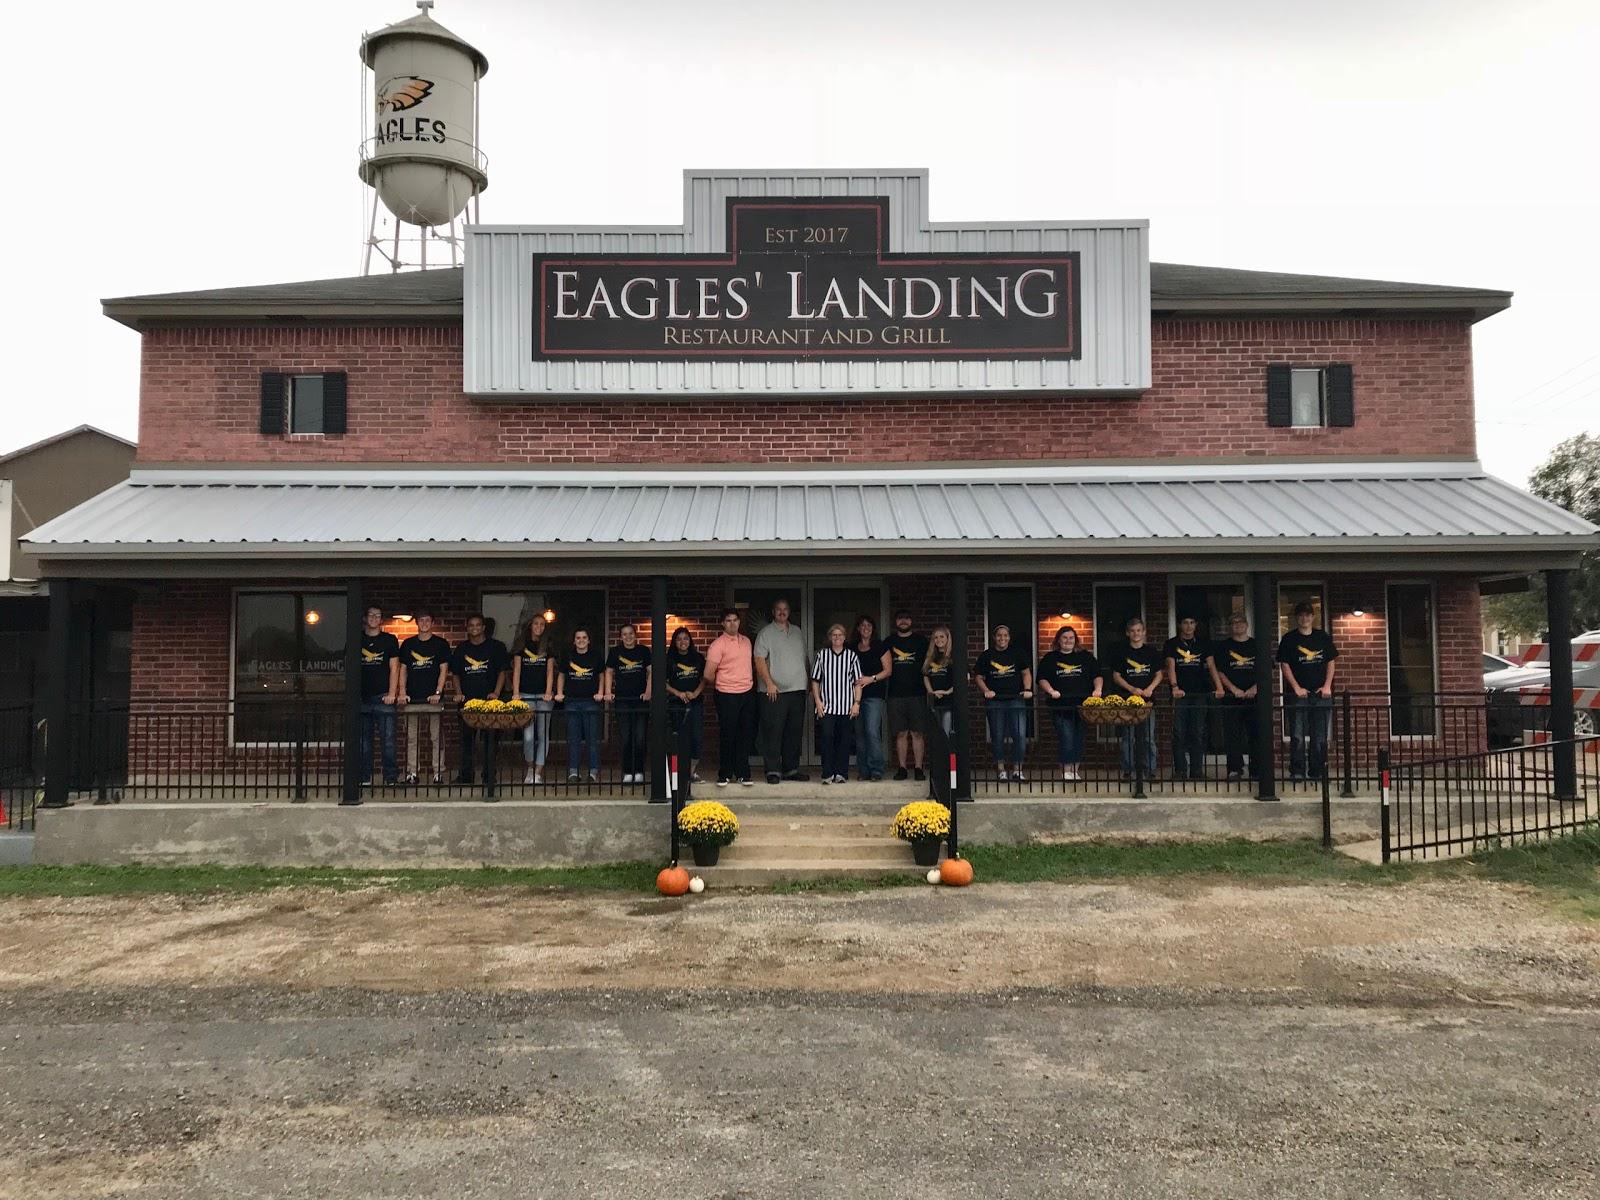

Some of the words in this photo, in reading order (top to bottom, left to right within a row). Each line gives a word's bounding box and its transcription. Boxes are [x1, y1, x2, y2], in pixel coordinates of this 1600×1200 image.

[376, 117, 446, 147] AGLES
[764, 227, 798, 243] EST
[803, 227, 849, 243] 2017
[552, 270, 762, 321] EAGLES'
[786, 268, 1059, 321] LANDING
[663, 325, 814, 346] RESTAURANT
[818, 327, 875, 346] AND
[880, 325, 951, 346] GRILL
[298, 659, 344, 673] LANDING
